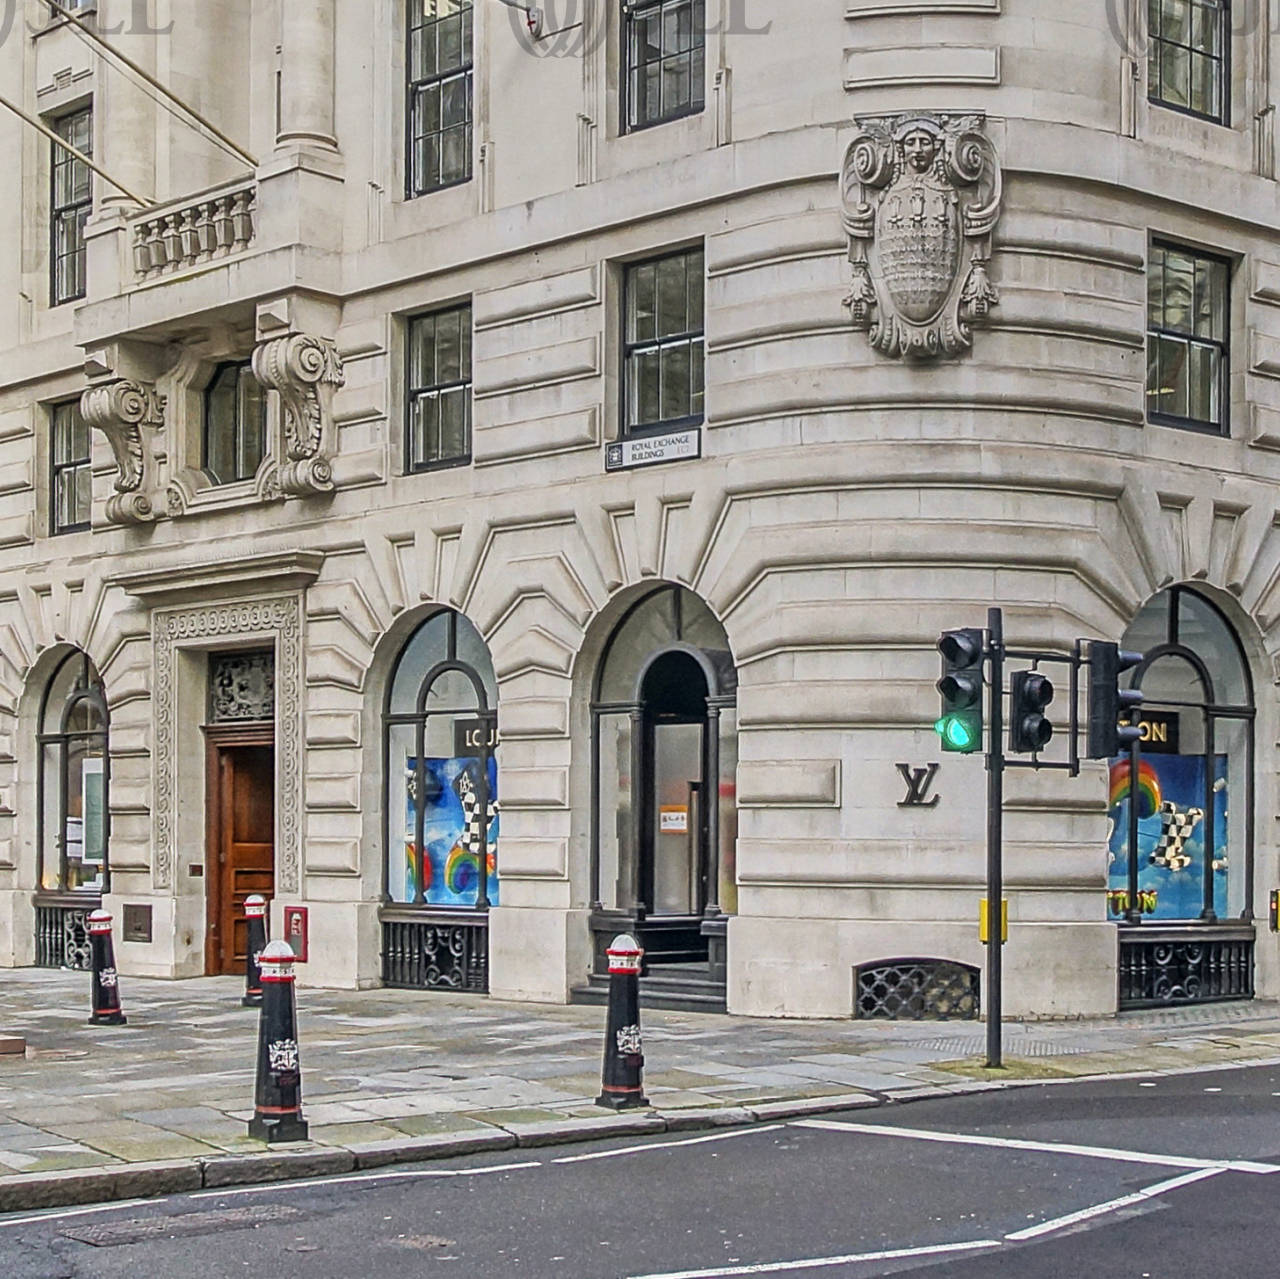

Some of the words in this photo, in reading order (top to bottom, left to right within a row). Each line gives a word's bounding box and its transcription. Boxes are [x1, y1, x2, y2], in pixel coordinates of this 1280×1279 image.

[631, 441, 652, 451] ROYAL
[653, 435, 689, 448] EXCHANGE
[631, 449, 665, 461] BUILDINGS
